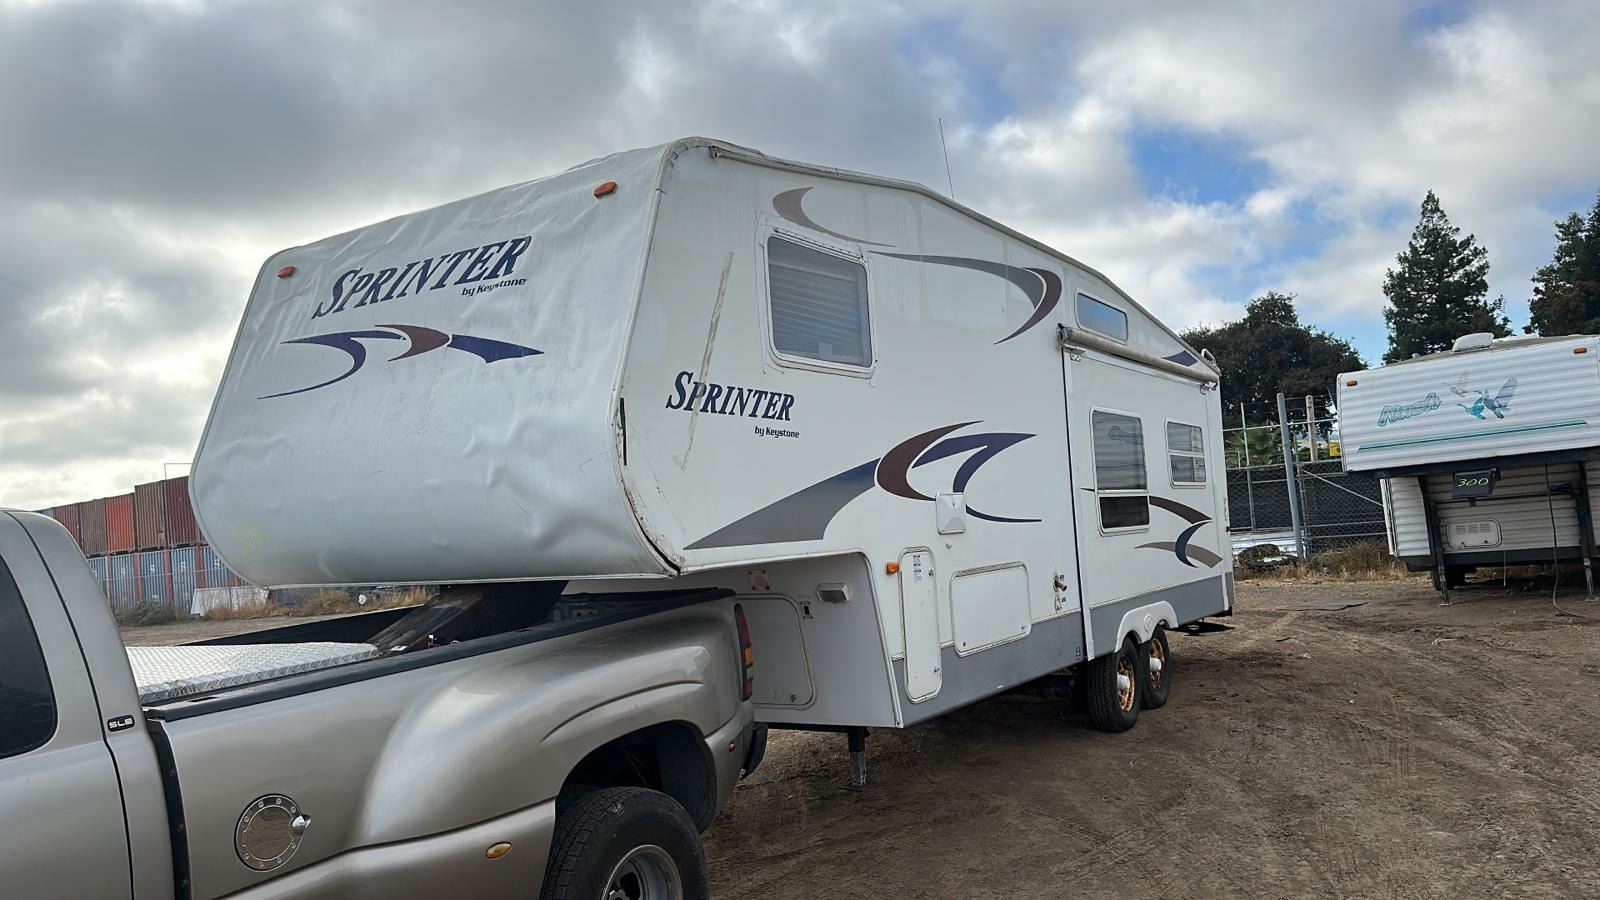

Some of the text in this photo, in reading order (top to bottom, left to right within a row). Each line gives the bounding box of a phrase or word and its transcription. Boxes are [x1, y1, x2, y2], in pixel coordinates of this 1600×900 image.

[310, 235, 533, 320] SPRINTER
[461, 278, 527, 297] by Keystone
[665, 370, 795, 422] SPRINTER
[754, 425, 800, 439] by Keystone
[1457, 477, 1489, 487] 300
